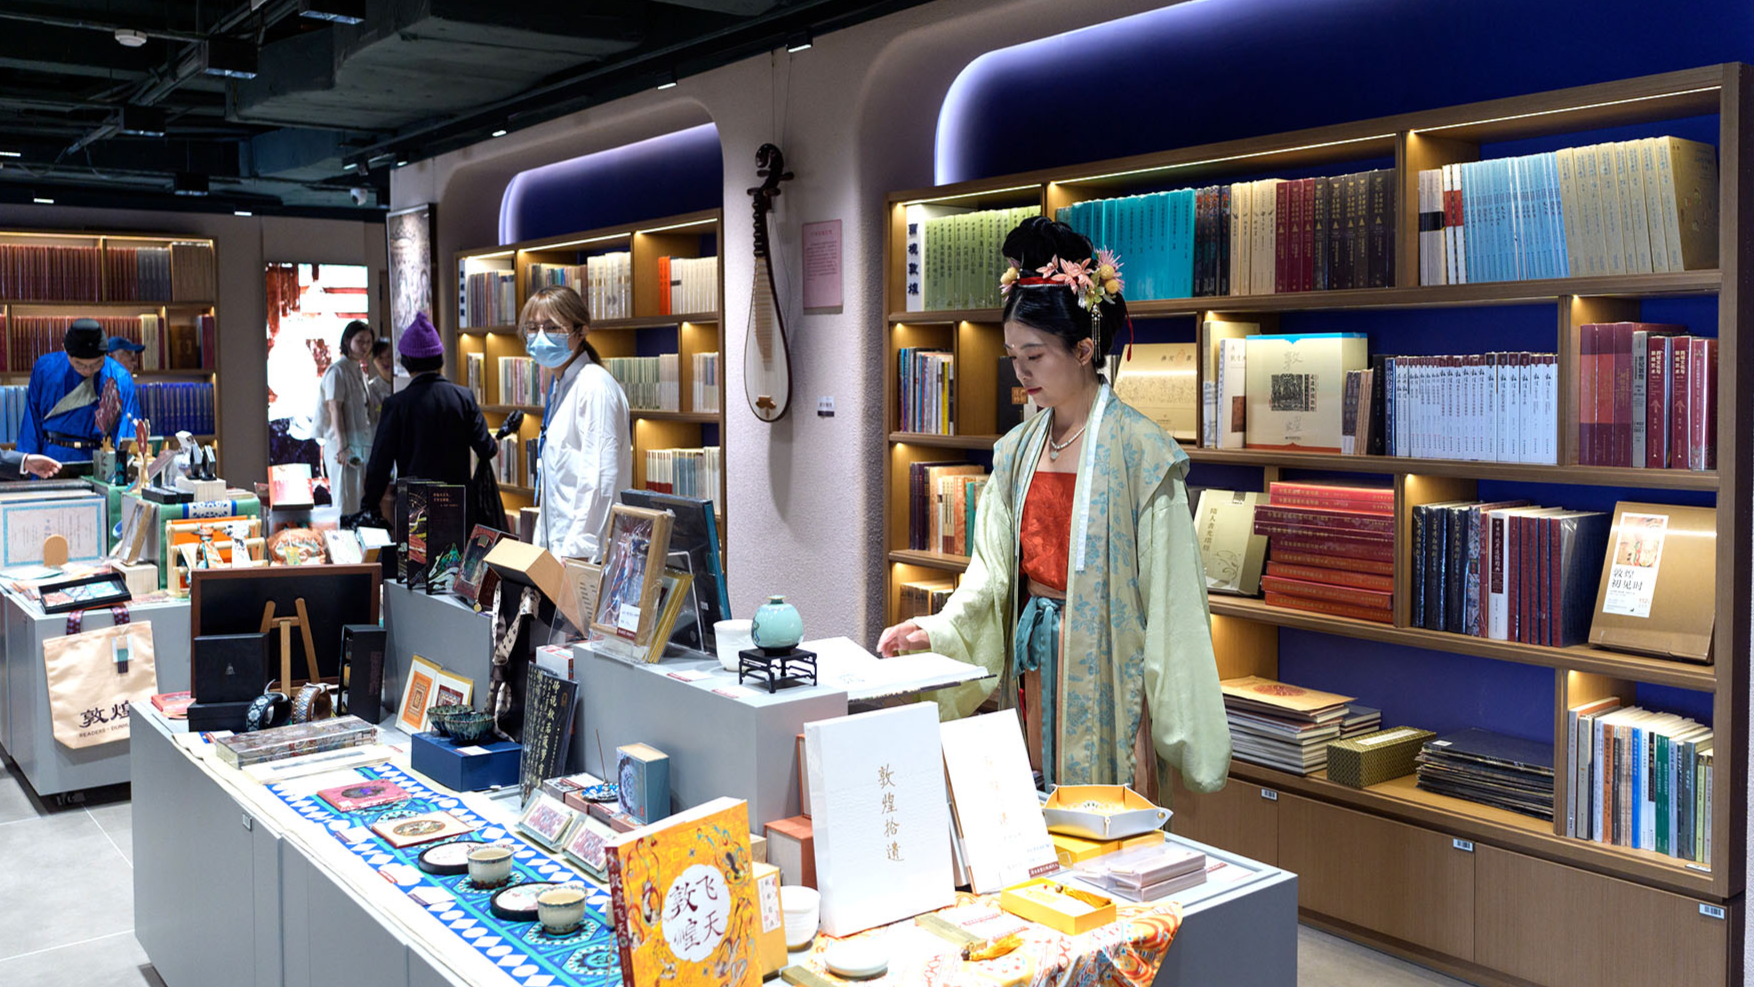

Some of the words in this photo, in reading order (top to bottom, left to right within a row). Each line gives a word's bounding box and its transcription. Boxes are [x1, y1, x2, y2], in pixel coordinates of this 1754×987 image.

[1613, 568, 1635, 579] 敦煌
[1611, 579, 1643, 591] 初见时
[79, 727, 106, 738] READERS
[696, 875, 724, 942] 飞天
[668, 881, 701, 952] 敦煌
